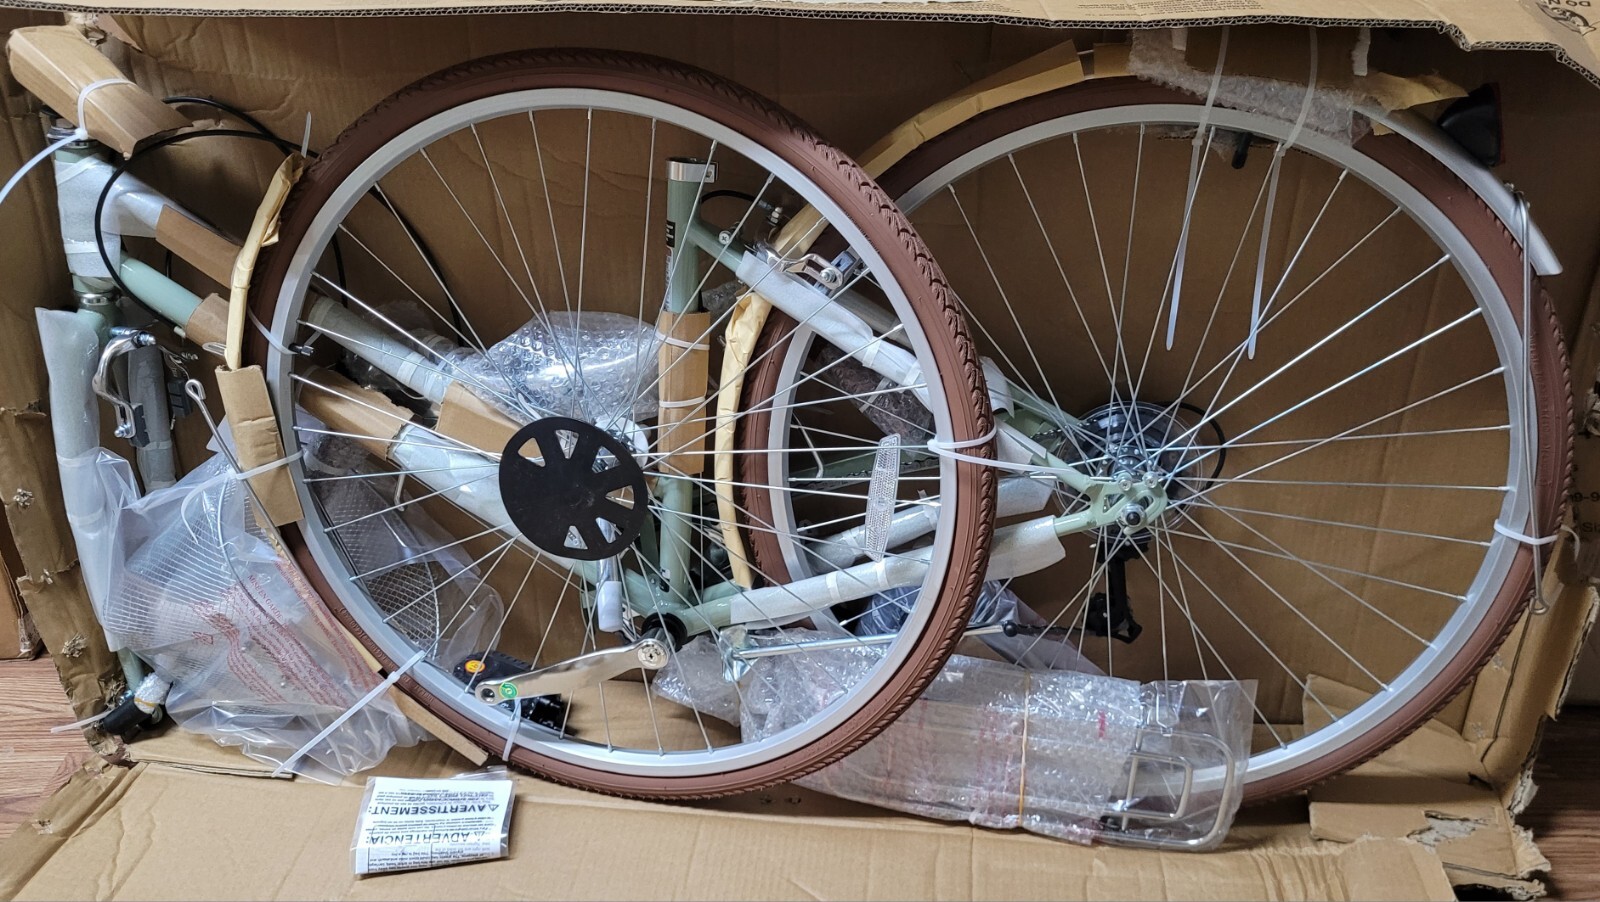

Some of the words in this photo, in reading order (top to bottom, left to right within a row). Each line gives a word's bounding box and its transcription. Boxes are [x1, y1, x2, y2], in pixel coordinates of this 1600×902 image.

[246, 574, 262, 591] MISE
[258, 588, 268, 599] EN
[264, 597, 284, 620] GARDE
[368, 804, 486, 816] AVERTISSEMENT:
[366, 832, 471, 846] ADVERTENCIA:
